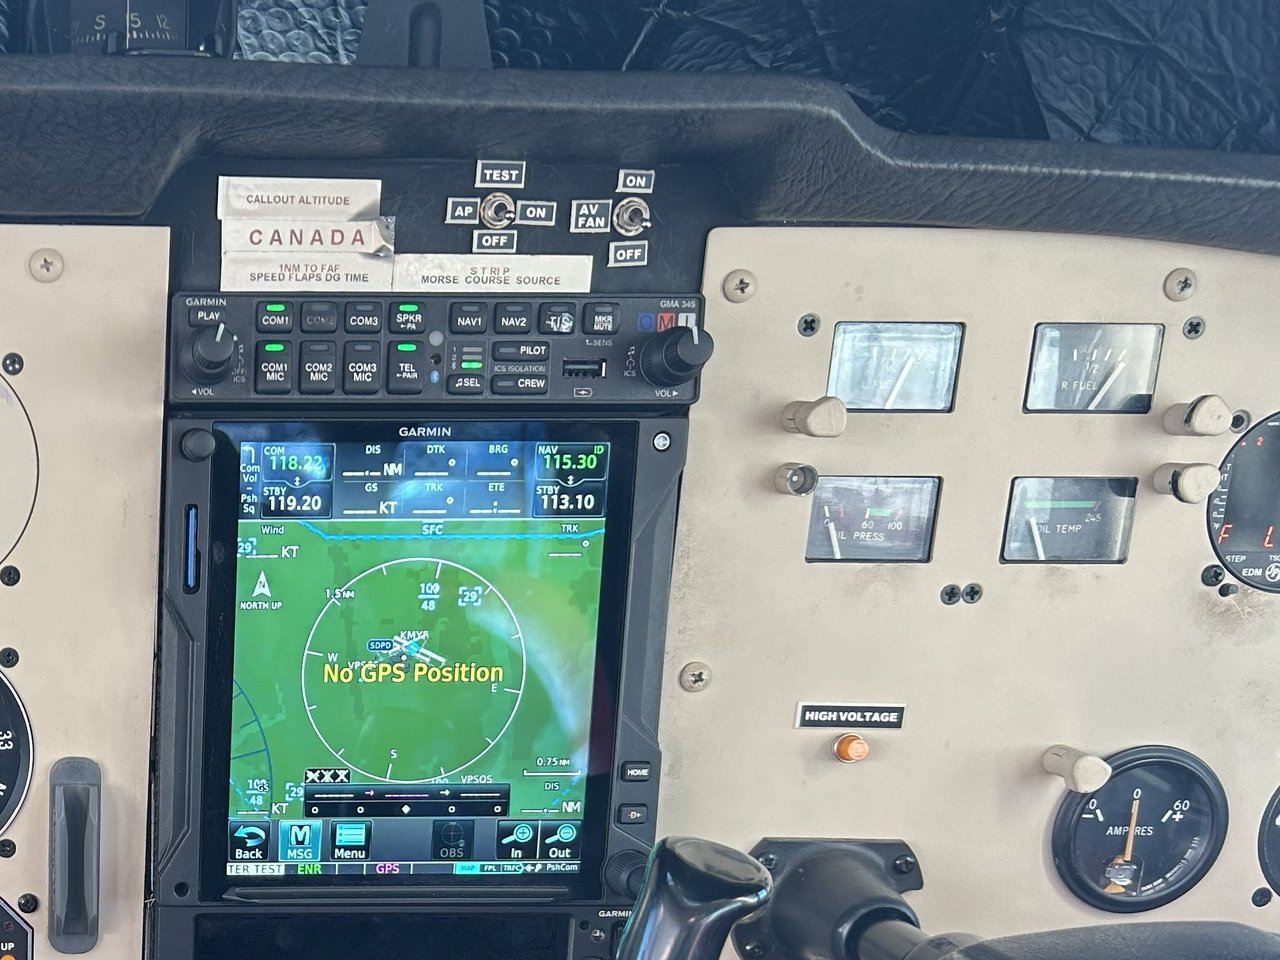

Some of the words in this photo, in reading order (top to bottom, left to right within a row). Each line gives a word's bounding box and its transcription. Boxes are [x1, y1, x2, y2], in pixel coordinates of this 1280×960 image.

[484, 170, 518, 180] TEST
[626, 176, 645, 187] ON
[246, 195, 294, 206] CALLOUT
[297, 195, 350, 206] ALTITUDE
[455, 206, 473, 217] AP
[526, 207, 545, 218] ON
[579, 204, 599, 215] AV
[577, 216, 605, 227] FAN
[249, 229, 365, 245] CANADA
[482, 236, 507, 247] OFF
[616, 249, 641, 260] OFF
[279, 264, 300, 272] 1NM
[303, 264, 317, 272] TO
[320, 265, 339, 273] FAF
[250, 272, 285, 282] SPEED
[288, 273, 323, 282] FLAPS
[325, 273, 341, 282] DG
[344, 274, 369, 282] TIME
[421, 275, 459, 284] MORSE
[465, 275, 509, 284] COURSE
[515, 276, 561, 285] SOURCE
[262, 316, 289, 325] COM1
[457, 318, 481, 326] NAV1
[501, 318, 526, 326] NAV2
[520, 346, 546, 355] PILOT
[518, 379, 545, 388] CREW
[398, 427, 451, 437] GARMIN
[264, 447, 284, 455] COM
[538, 446, 558, 454] NAV
[270, 456, 322, 470] 118.22
[544, 455, 596, 469] 115.30
[263, 487, 286, 496] STBY
[536, 486, 559, 494] STBY
[269, 496, 321, 510] 119.20
[541, 495, 594, 509] 113.10
[323, 664, 353, 683] No
[361, 664, 405, 683] GPS
[414, 664, 503, 682] Position
[805, 711, 837, 721] HIGH
[839, 712, 898, 722] VOLTAGE
[235, 849, 262, 859] Back
[288, 850, 312, 859] MSG
[335, 850, 365, 859] Menu
